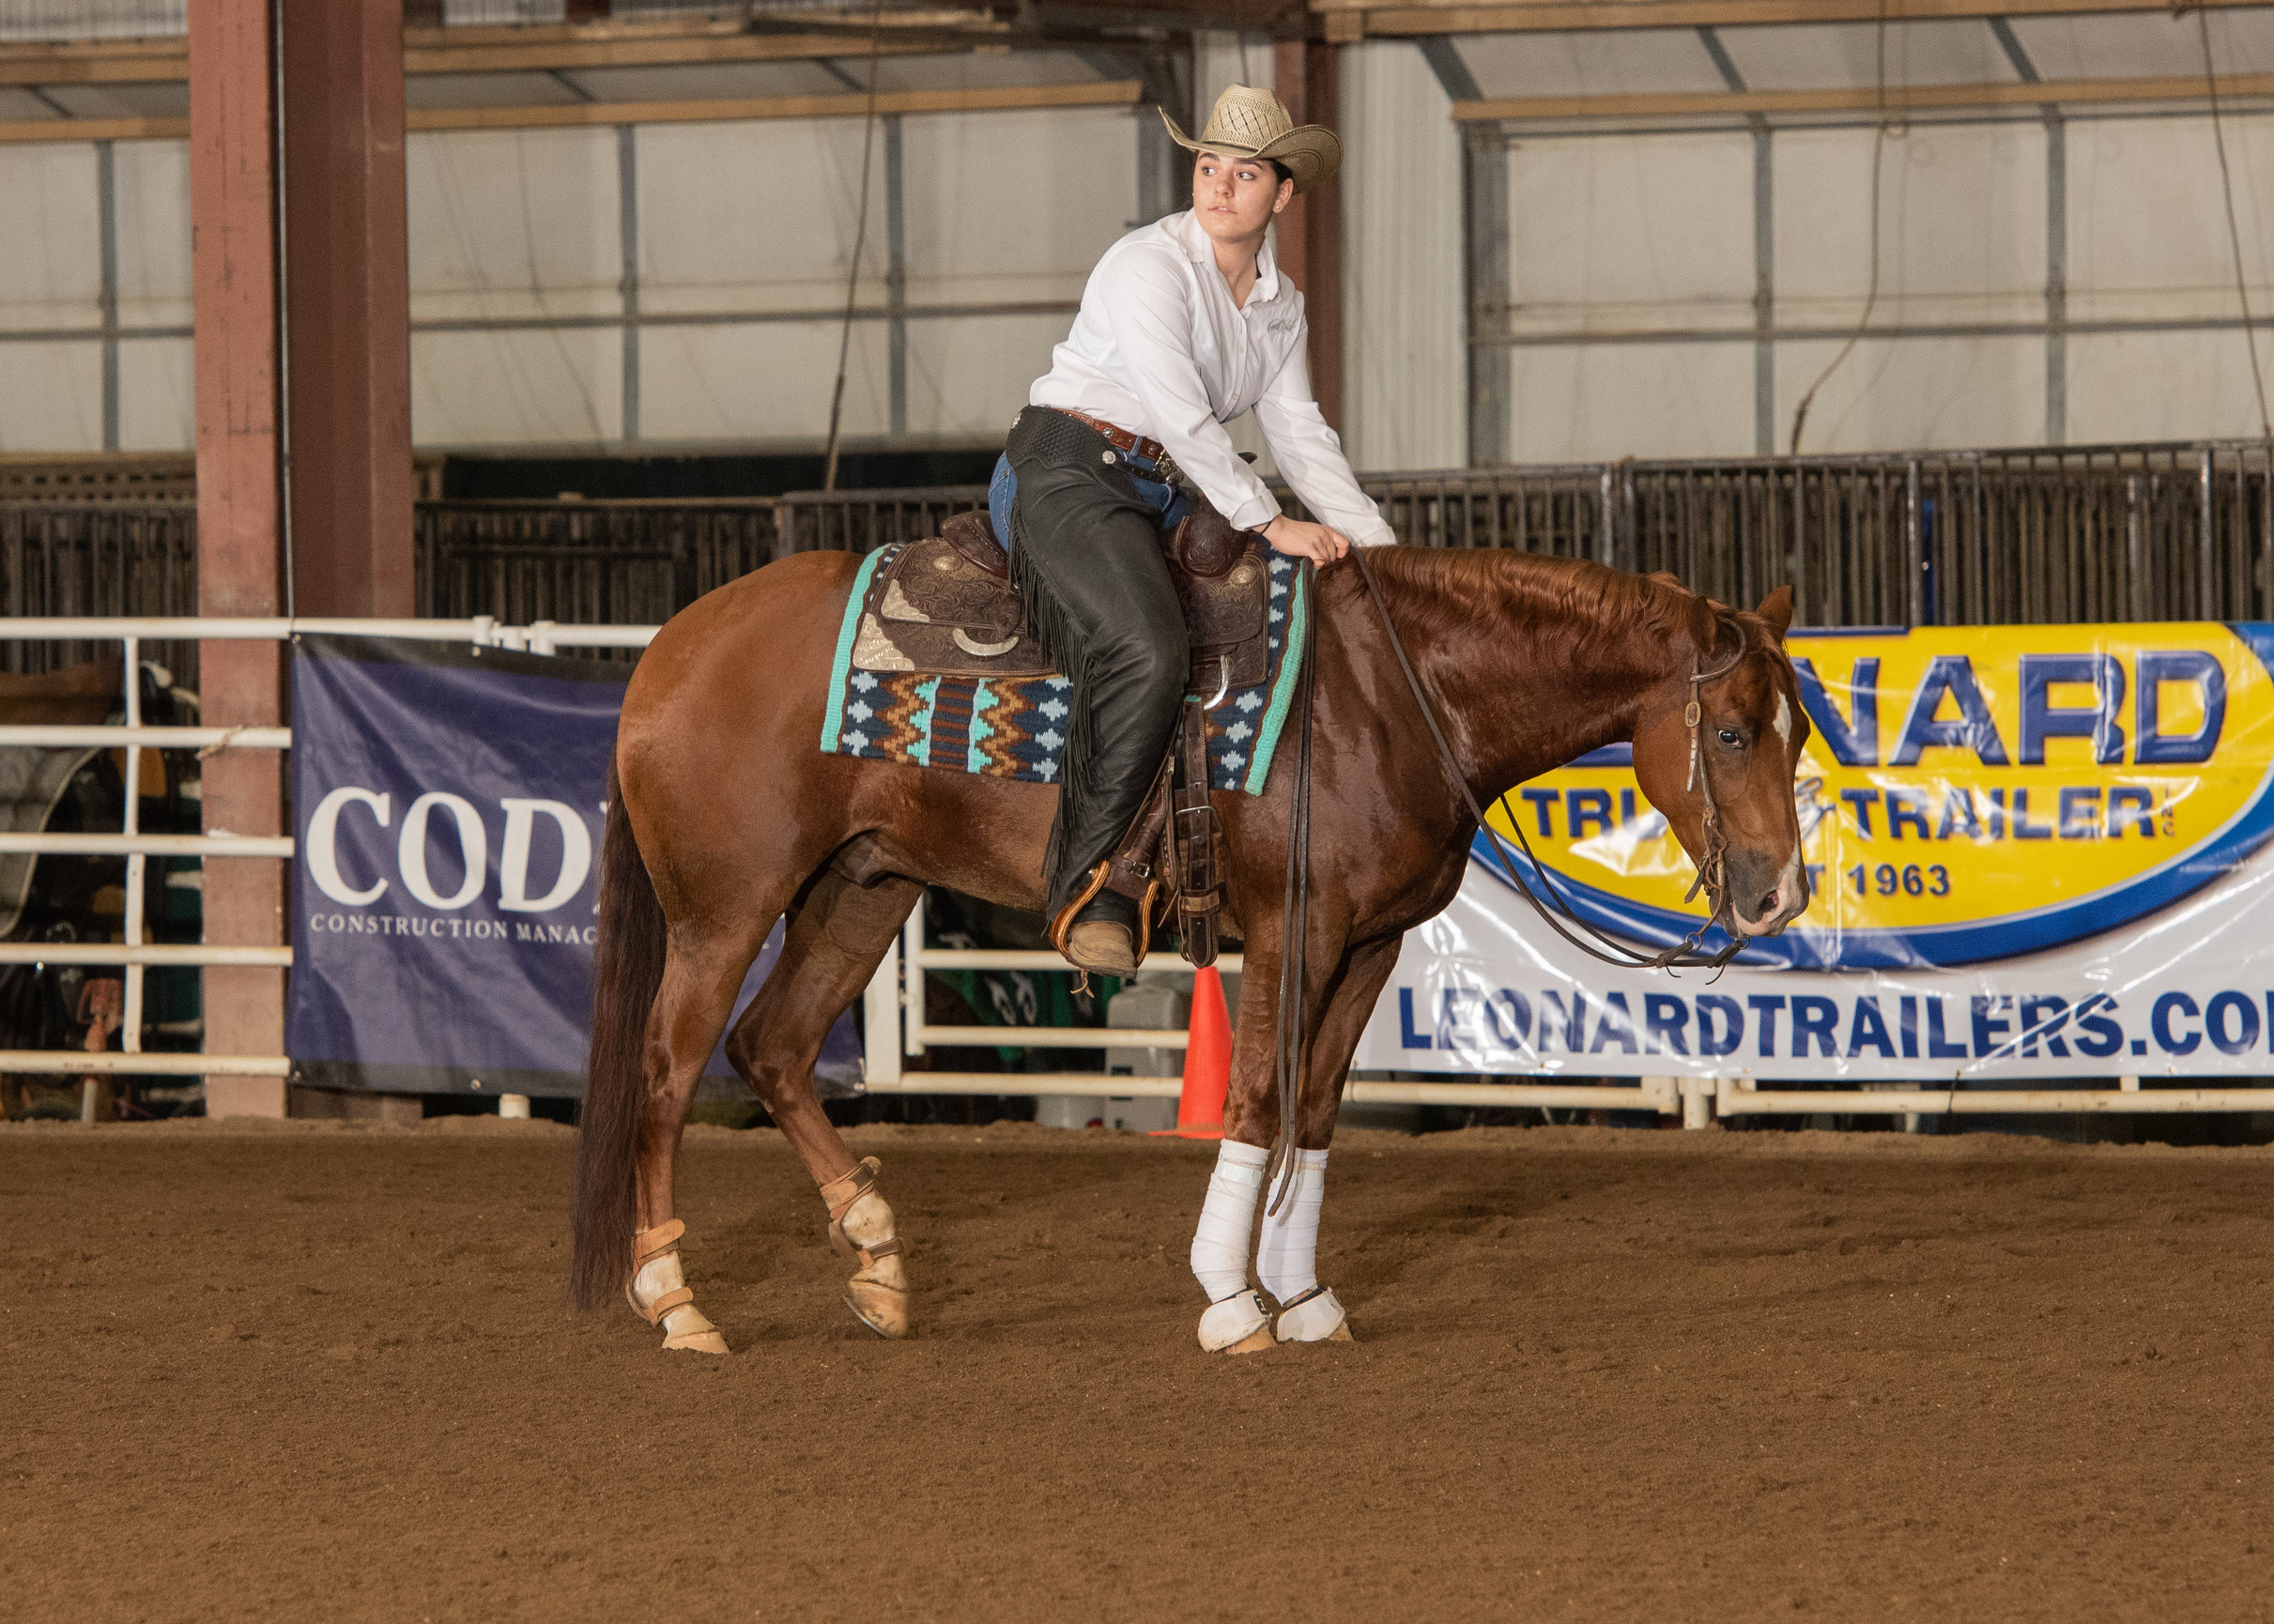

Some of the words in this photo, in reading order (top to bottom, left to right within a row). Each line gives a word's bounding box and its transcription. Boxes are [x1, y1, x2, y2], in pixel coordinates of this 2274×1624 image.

[1789, 650, 2228, 767] NARD
[1840, 786, 2156, 840] TRAILER
[306, 786, 611, 913] COD
[1847, 862, 1950, 896] 1963
[310, 912, 508, 939] CONSTRUCTION
[1399, 987, 2274, 1061] LEONARDTRAILERS.CO
